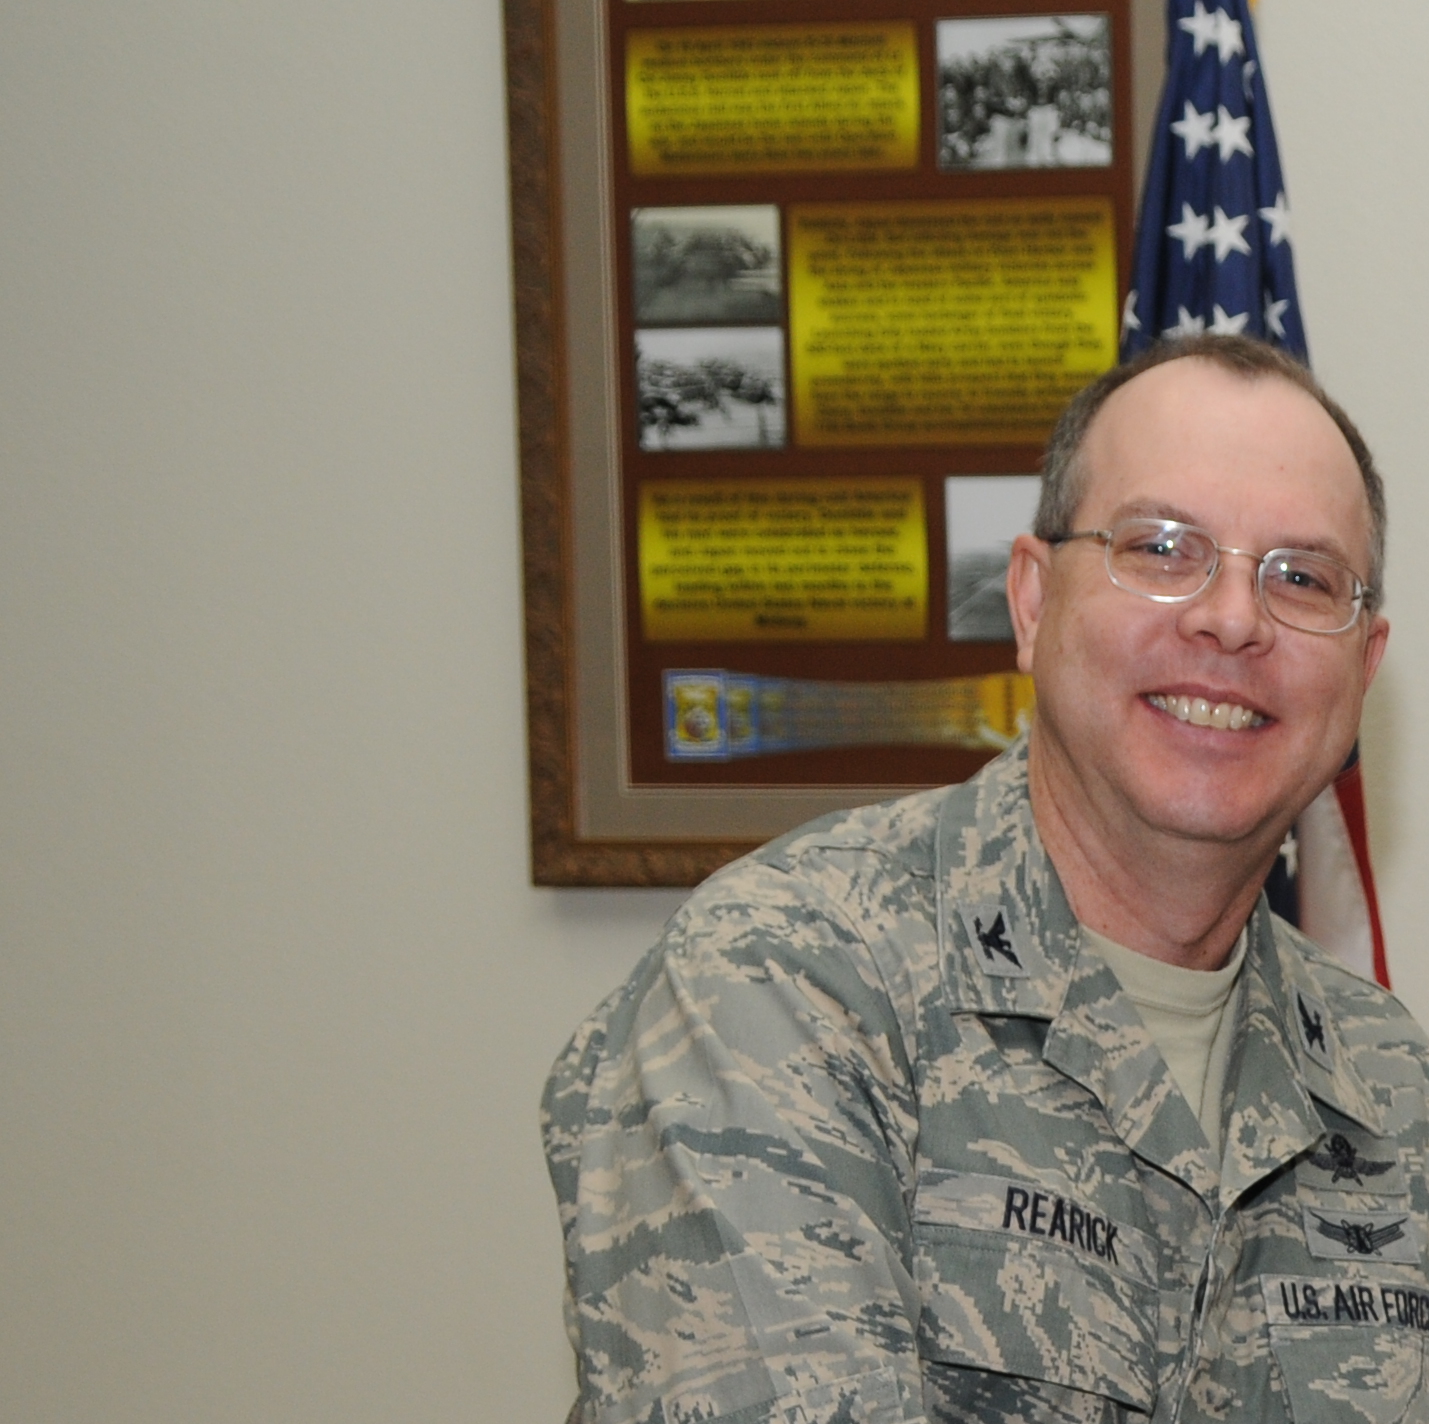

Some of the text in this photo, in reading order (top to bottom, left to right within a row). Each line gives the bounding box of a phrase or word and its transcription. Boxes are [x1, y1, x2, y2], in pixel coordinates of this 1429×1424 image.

[1002, 1186, 1119, 1266] REARICK
[1280, 1282, 1328, 1320] U.S.
[1335, 1284, 1379, 1321] AIR
